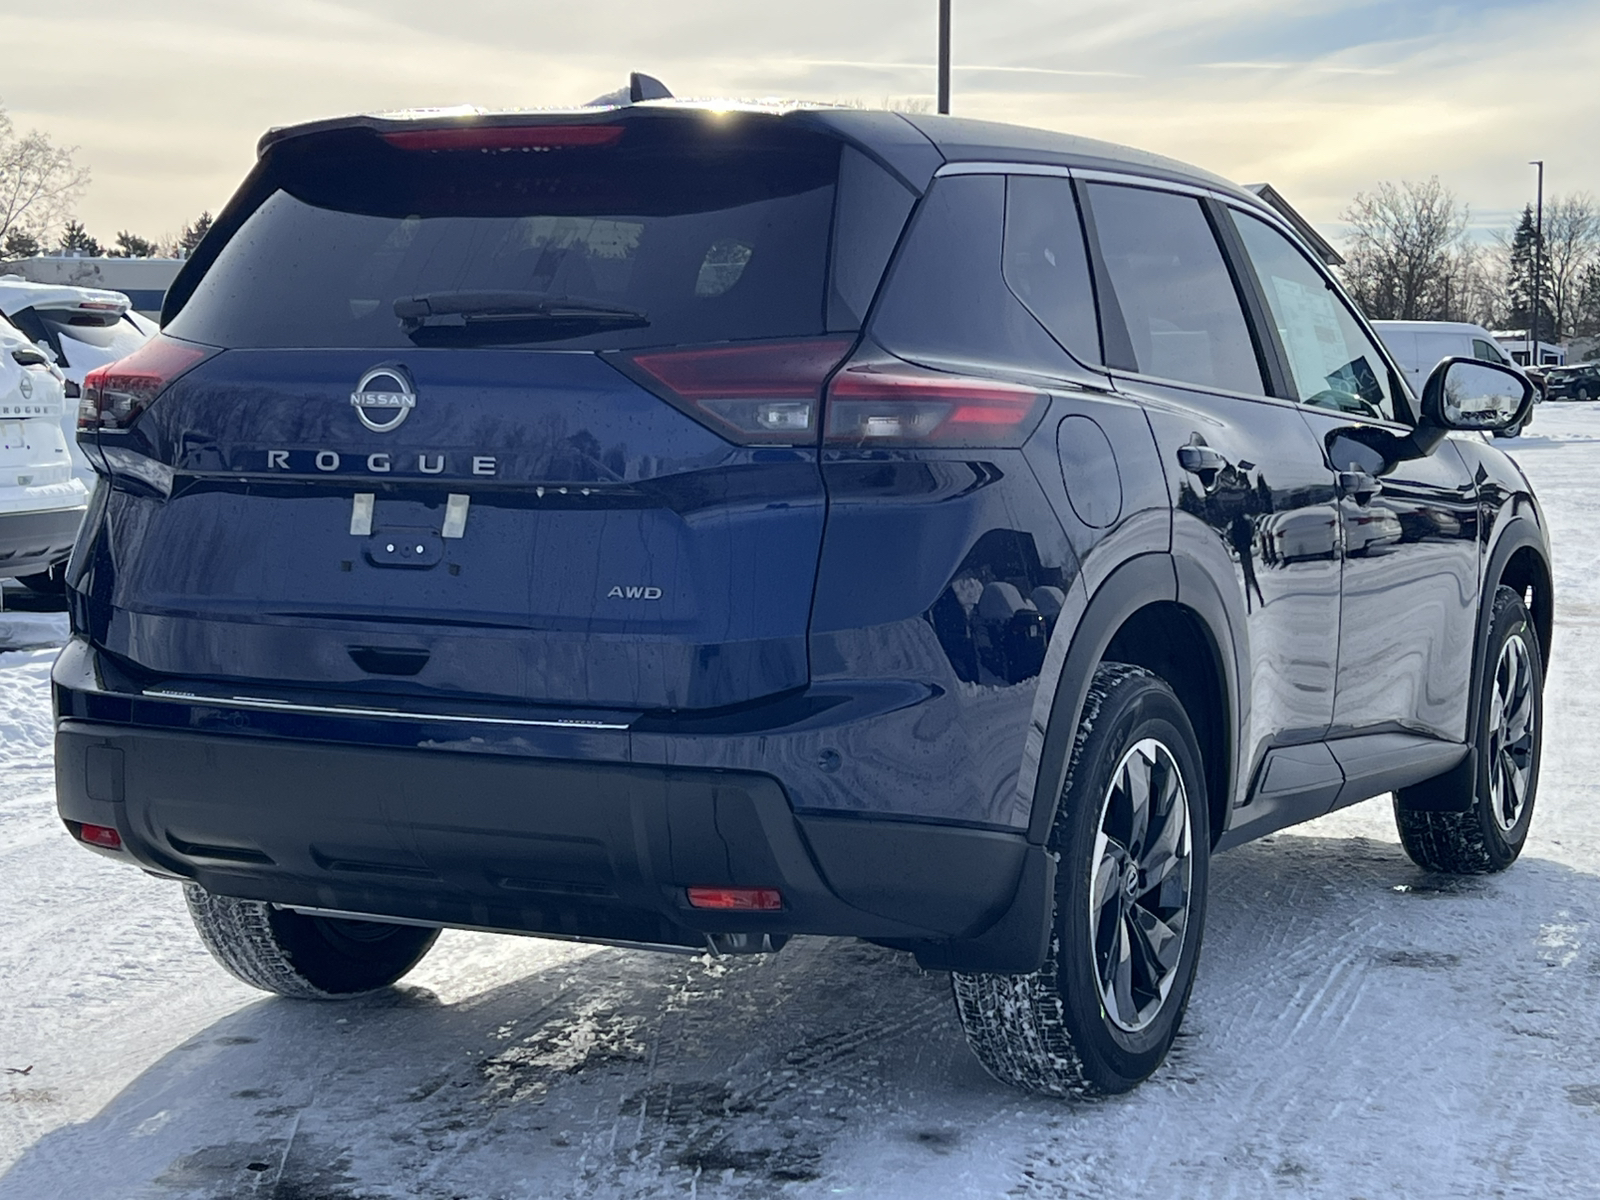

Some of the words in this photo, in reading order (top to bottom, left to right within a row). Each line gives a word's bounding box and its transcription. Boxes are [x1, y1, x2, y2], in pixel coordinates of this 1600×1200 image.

[351, 394, 414, 405] NISSAN
[3, 406, 48, 414] ROGUE
[267, 450, 497, 475] ROGUE
[607, 586, 662, 599] AWD
